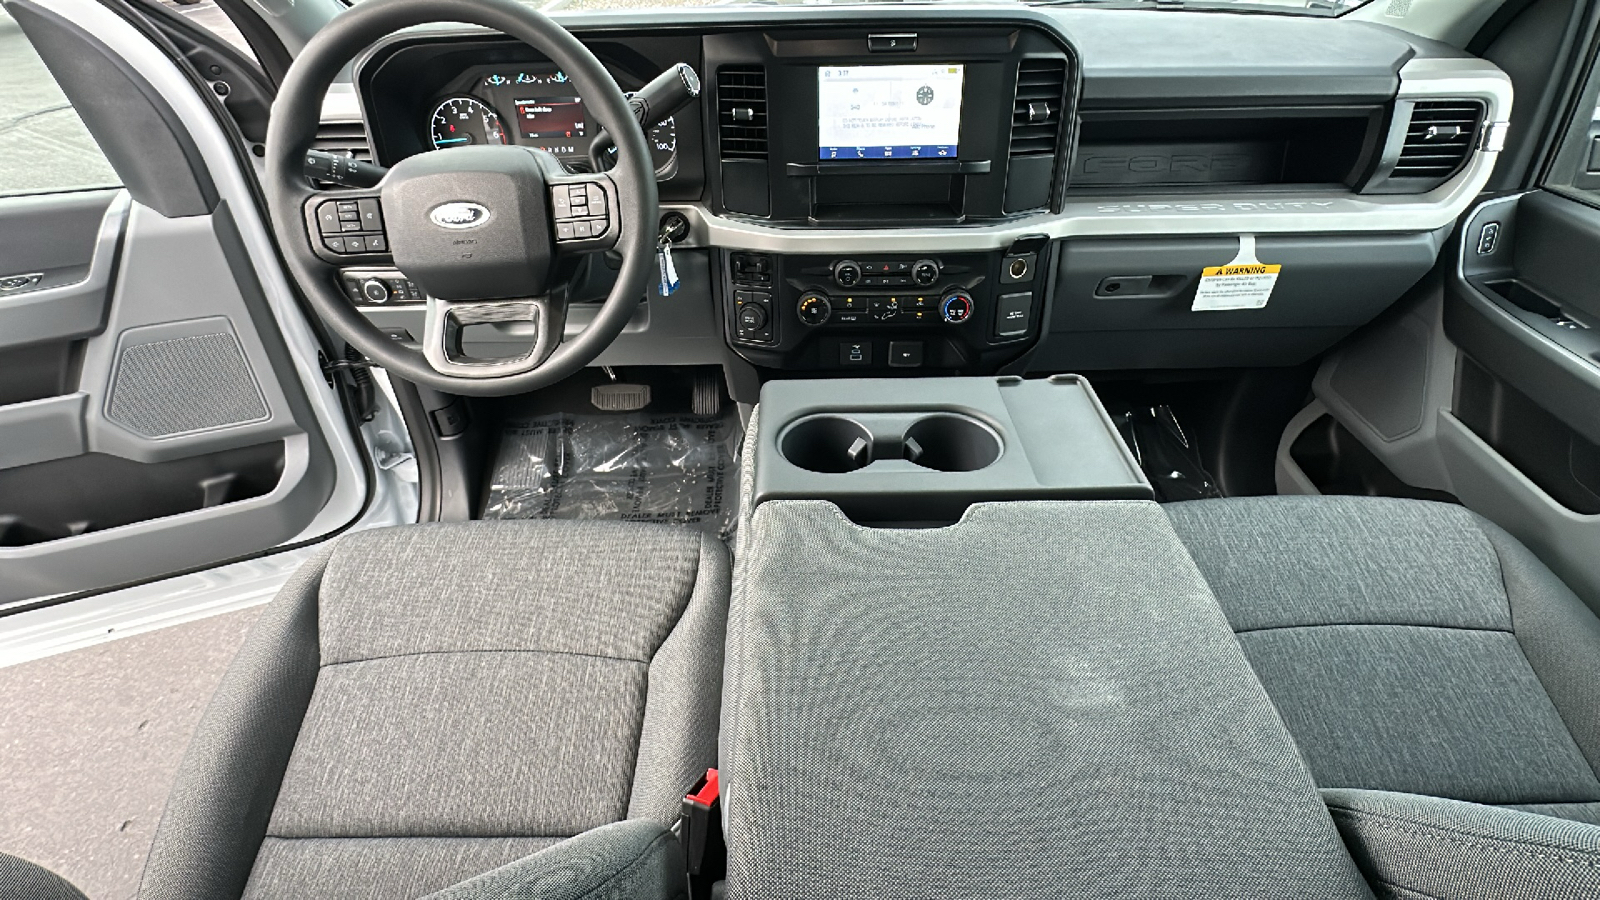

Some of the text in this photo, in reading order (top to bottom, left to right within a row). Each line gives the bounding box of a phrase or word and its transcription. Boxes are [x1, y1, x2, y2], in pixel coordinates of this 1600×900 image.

[467, 106, 474, 114] 4
[492, 131, 500, 139] 6
[656, 142, 669, 150] 100
[1097, 200, 1334, 213] SUPER DUTY
[1225, 266, 1266, 275] WARNING
[704, 486, 714, 509] DEALER
[620, 512, 652, 520] DEALER
